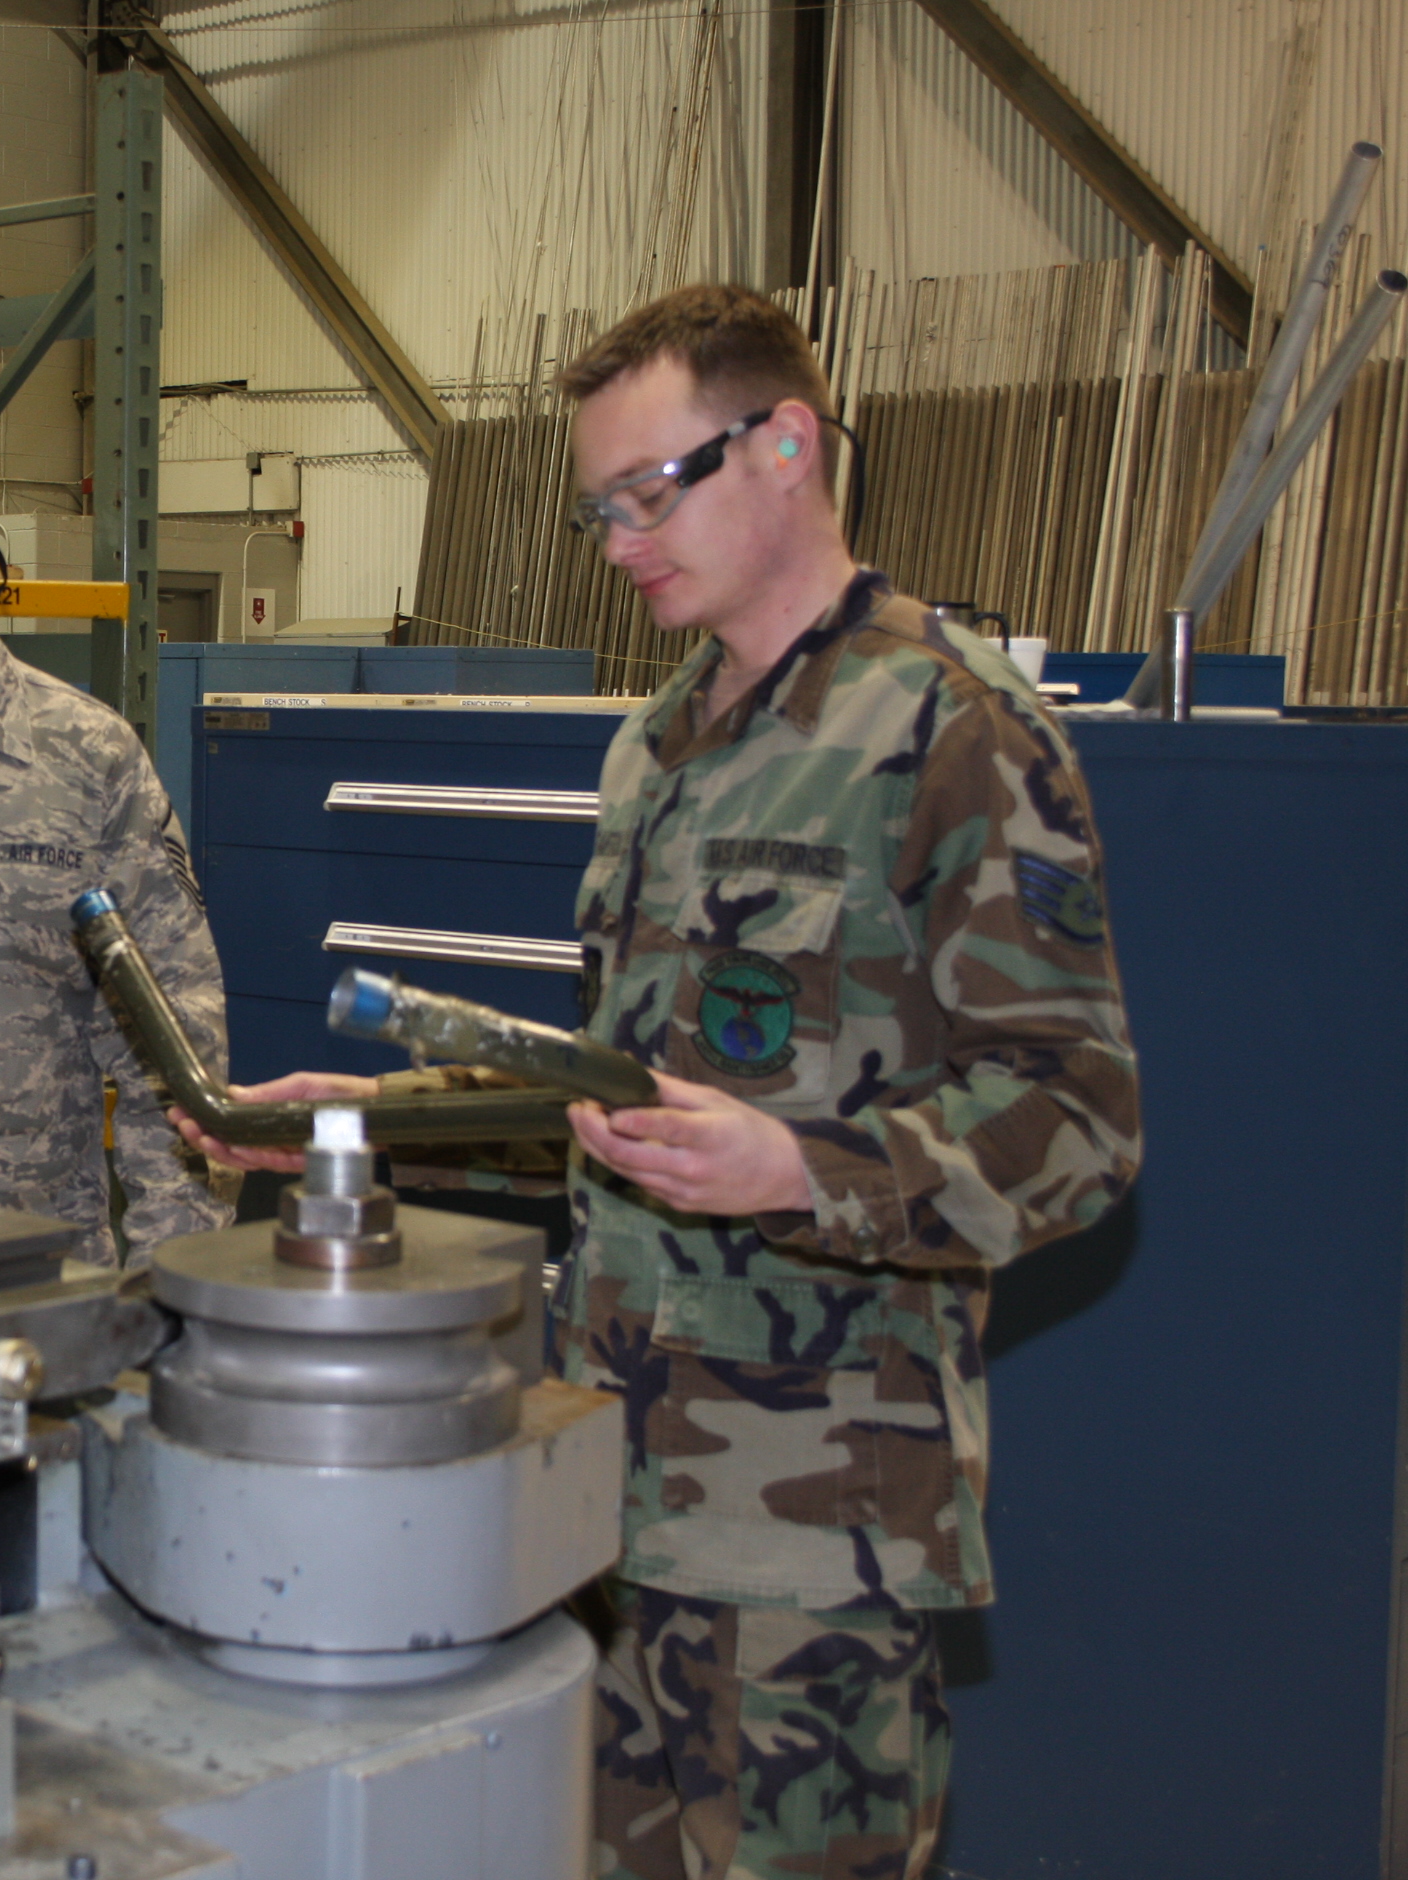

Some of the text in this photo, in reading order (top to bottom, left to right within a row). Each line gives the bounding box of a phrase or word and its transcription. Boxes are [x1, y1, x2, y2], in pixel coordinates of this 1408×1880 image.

[264, 697, 286, 706] BENCH
[288, 698, 310, 706] STOCK
[9, 844, 32, 862] AIR
[37, 845, 84, 869] FORCE
[767, 841, 845, 878] FORCE
